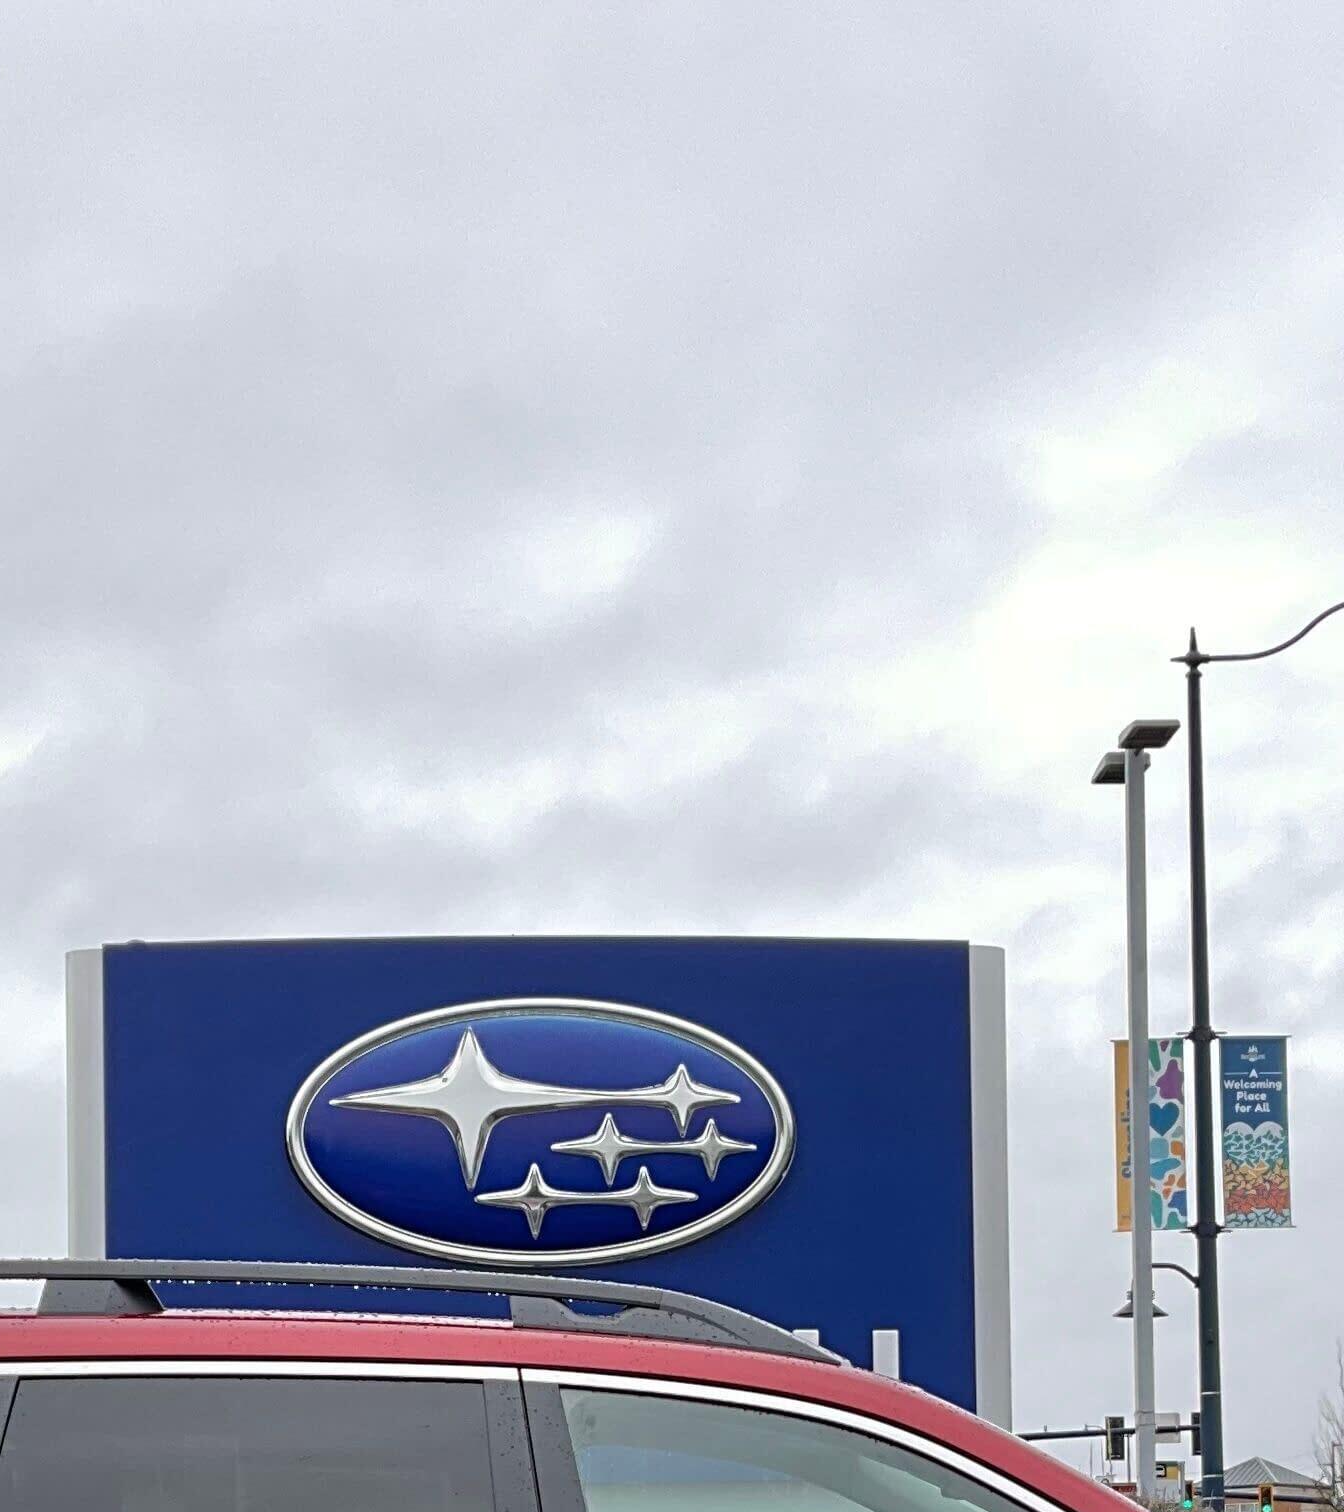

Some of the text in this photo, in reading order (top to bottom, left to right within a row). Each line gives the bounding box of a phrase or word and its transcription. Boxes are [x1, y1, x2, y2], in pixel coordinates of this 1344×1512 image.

[1248, 1068, 1259, 1078] A
[1223, 1079, 1283, 1091] Welcoming
[1236, 1091, 1267, 1101] Place
[1234, 1102, 1271, 1113] for All
